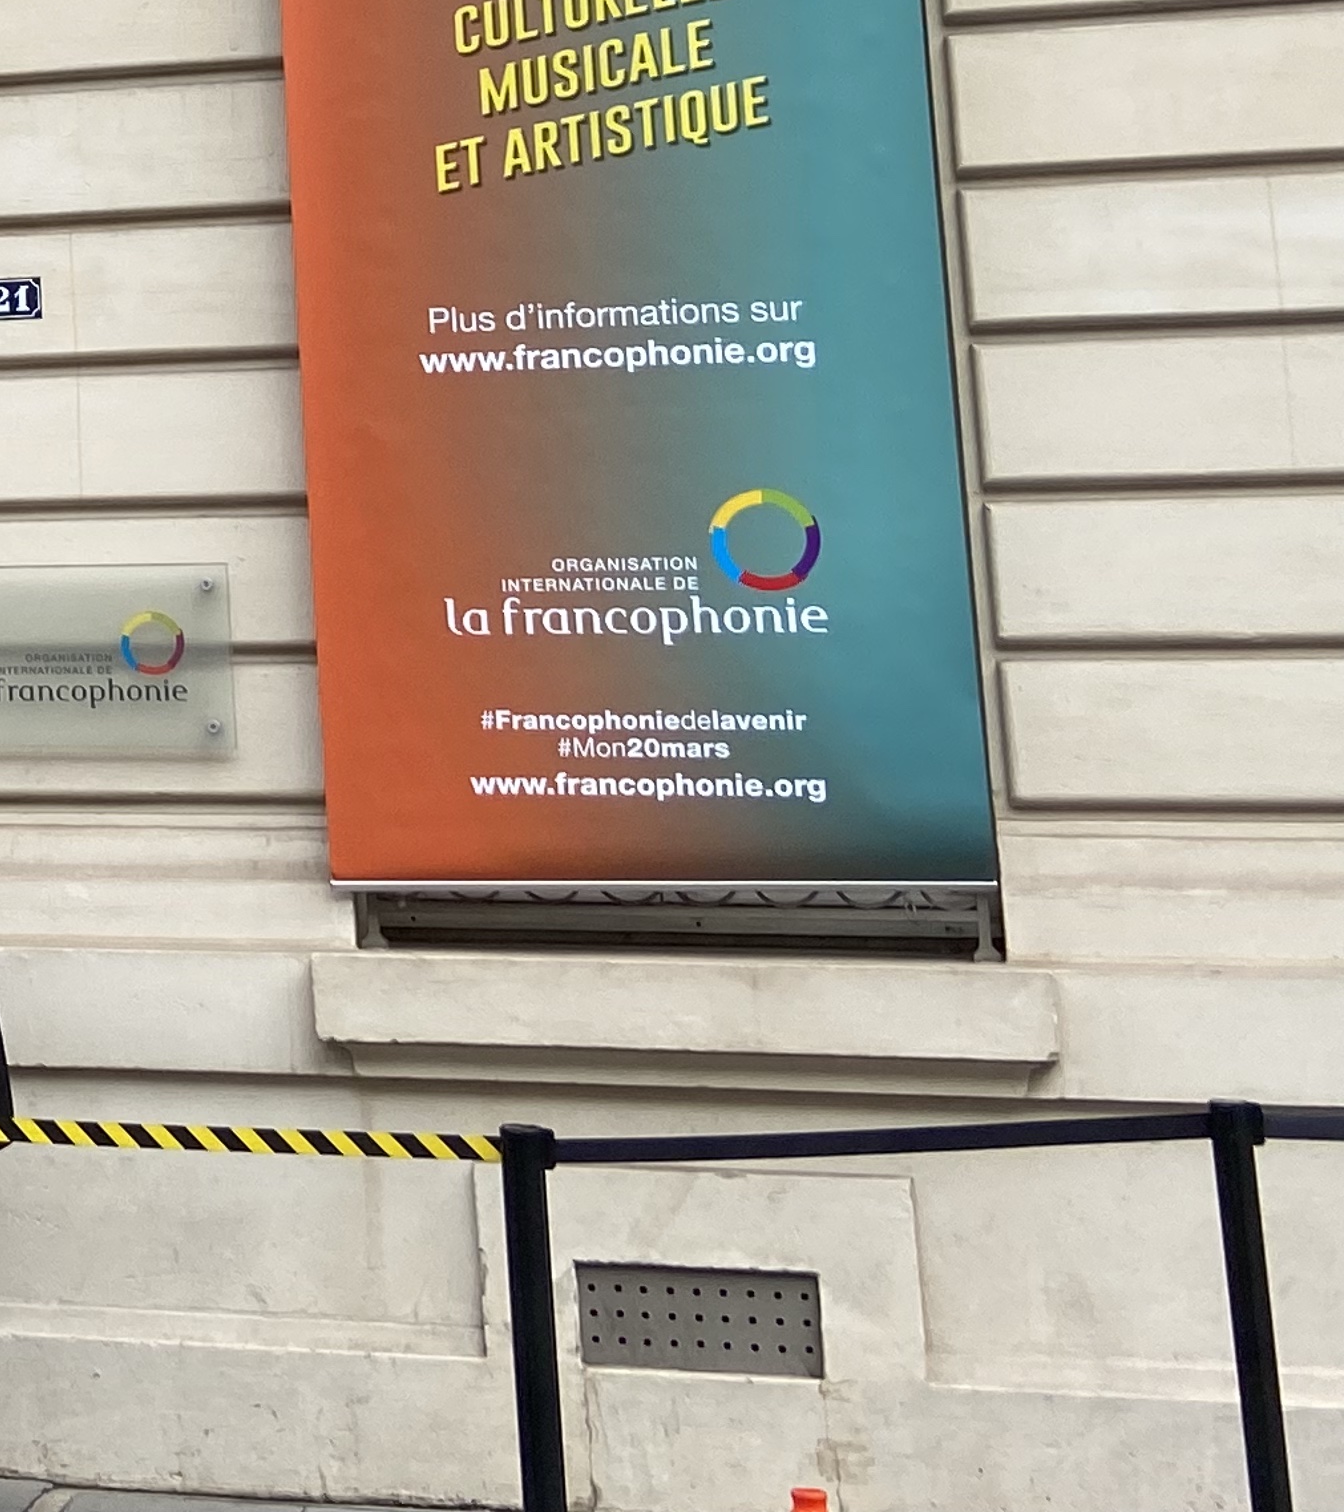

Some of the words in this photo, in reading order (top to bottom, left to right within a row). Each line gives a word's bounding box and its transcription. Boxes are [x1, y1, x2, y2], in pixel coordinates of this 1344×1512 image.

[479, 19, 714, 116] MUSICALE
[435, 135, 485, 193] ET
[503, 75, 771, 179] ARTISTIQUE
[428, 305, 496, 334] Plus
[750, 299, 802, 323] sur
[419, 337, 817, 373] www.francophonie.org
[551, 556, 698, 572] ORGANISATION
[501, 577, 666, 593] INTERNATIONALE
[673, 576, 699, 591] DE
[444, 597, 491, 636] la
[502, 595, 829, 646] francophonie
[25, 652, 113, 663] ORGANISATION
[96, 665, 113, 675] DE
[480, 709, 807, 734] #Francophoniedelavenir
[557, 738, 731, 759] #Mon20mars
[470, 771, 827, 802] www.francophonie.org
